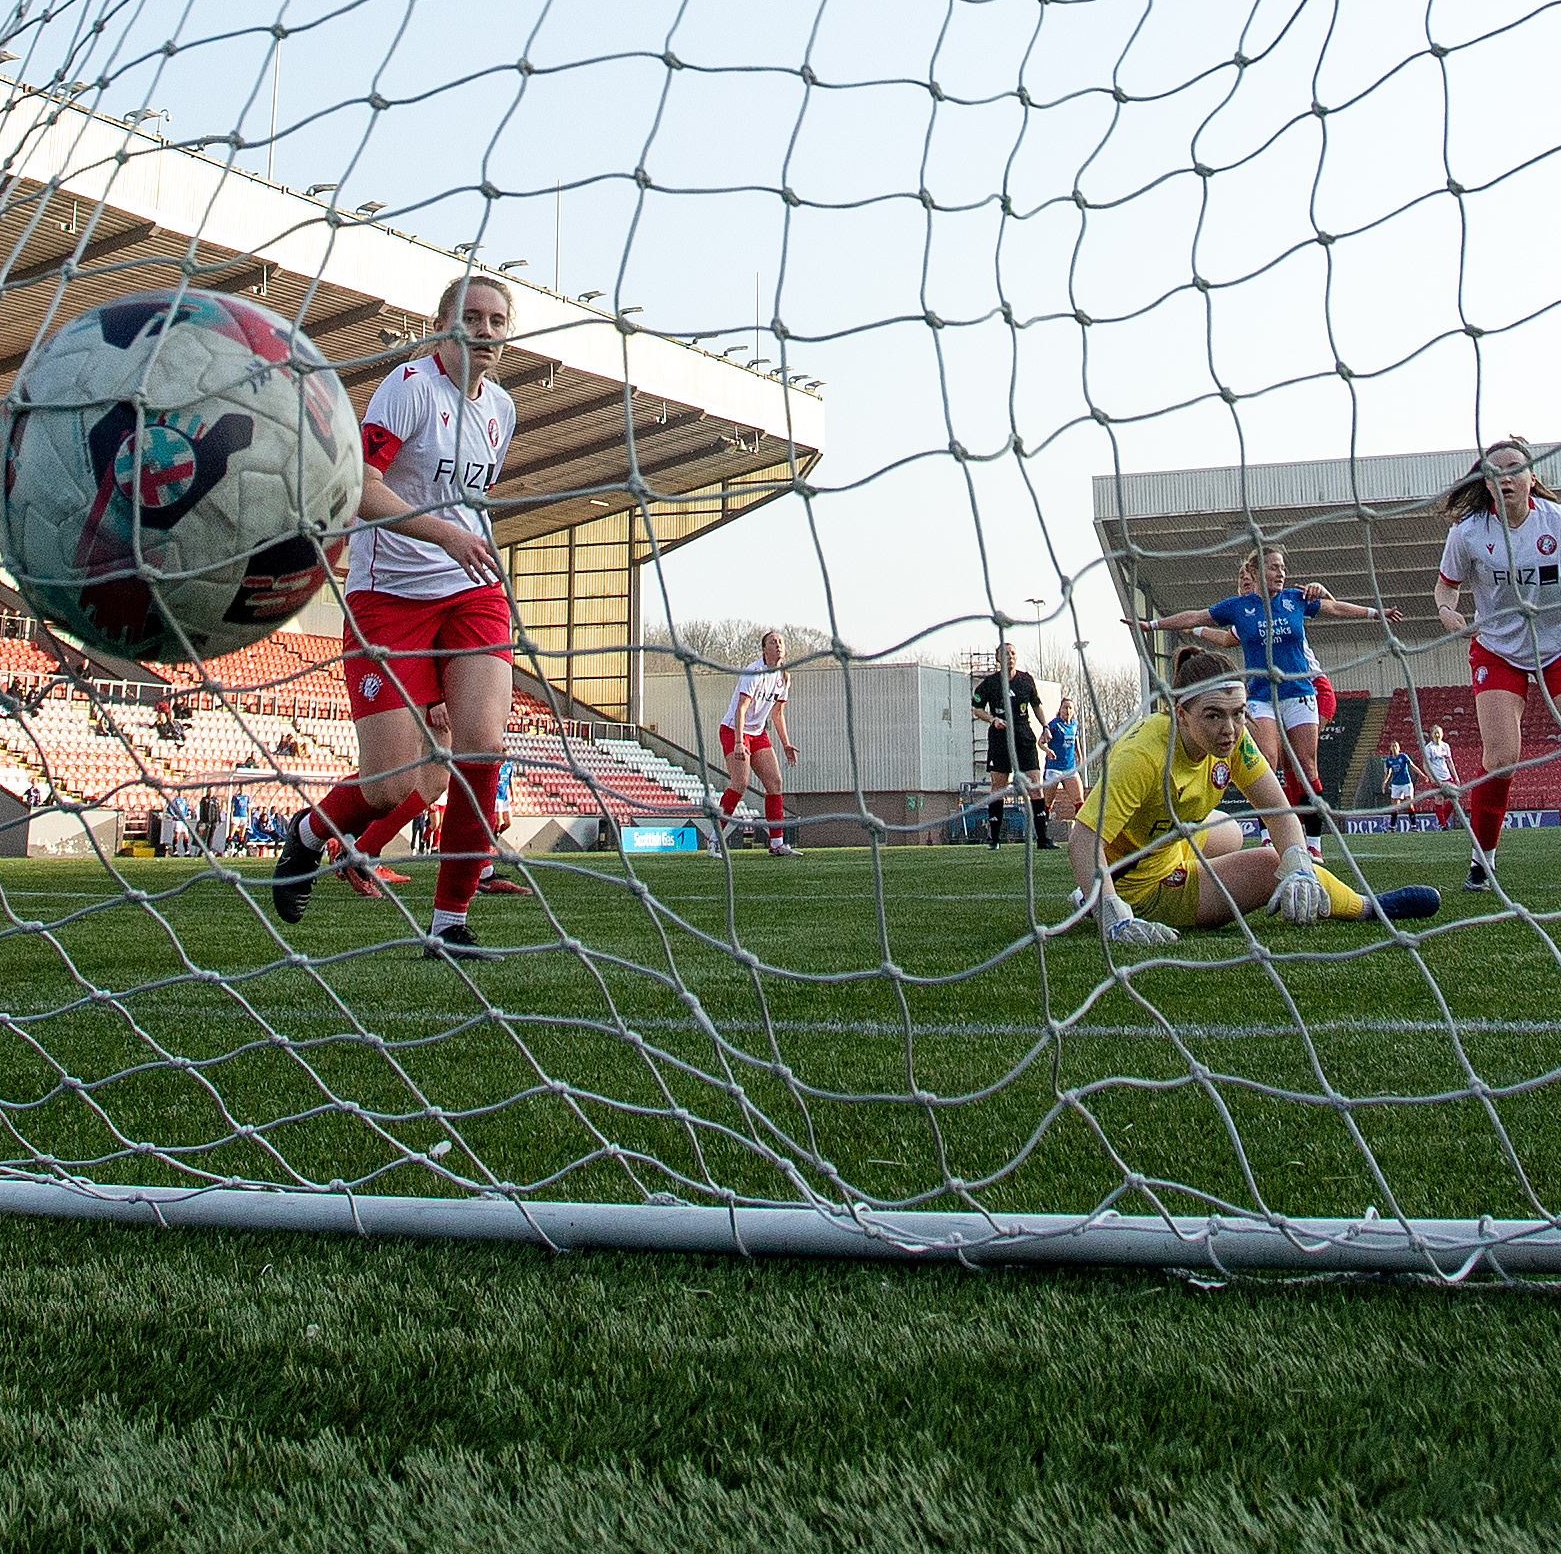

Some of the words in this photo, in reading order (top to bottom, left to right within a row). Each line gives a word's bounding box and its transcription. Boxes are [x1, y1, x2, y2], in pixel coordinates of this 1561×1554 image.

[1347, 819, 1378, 834] DCP
[1399, 818, 1431, 833] DP
[633, 831, 661, 847] Scottish
[662, 831, 675, 846] Gas
